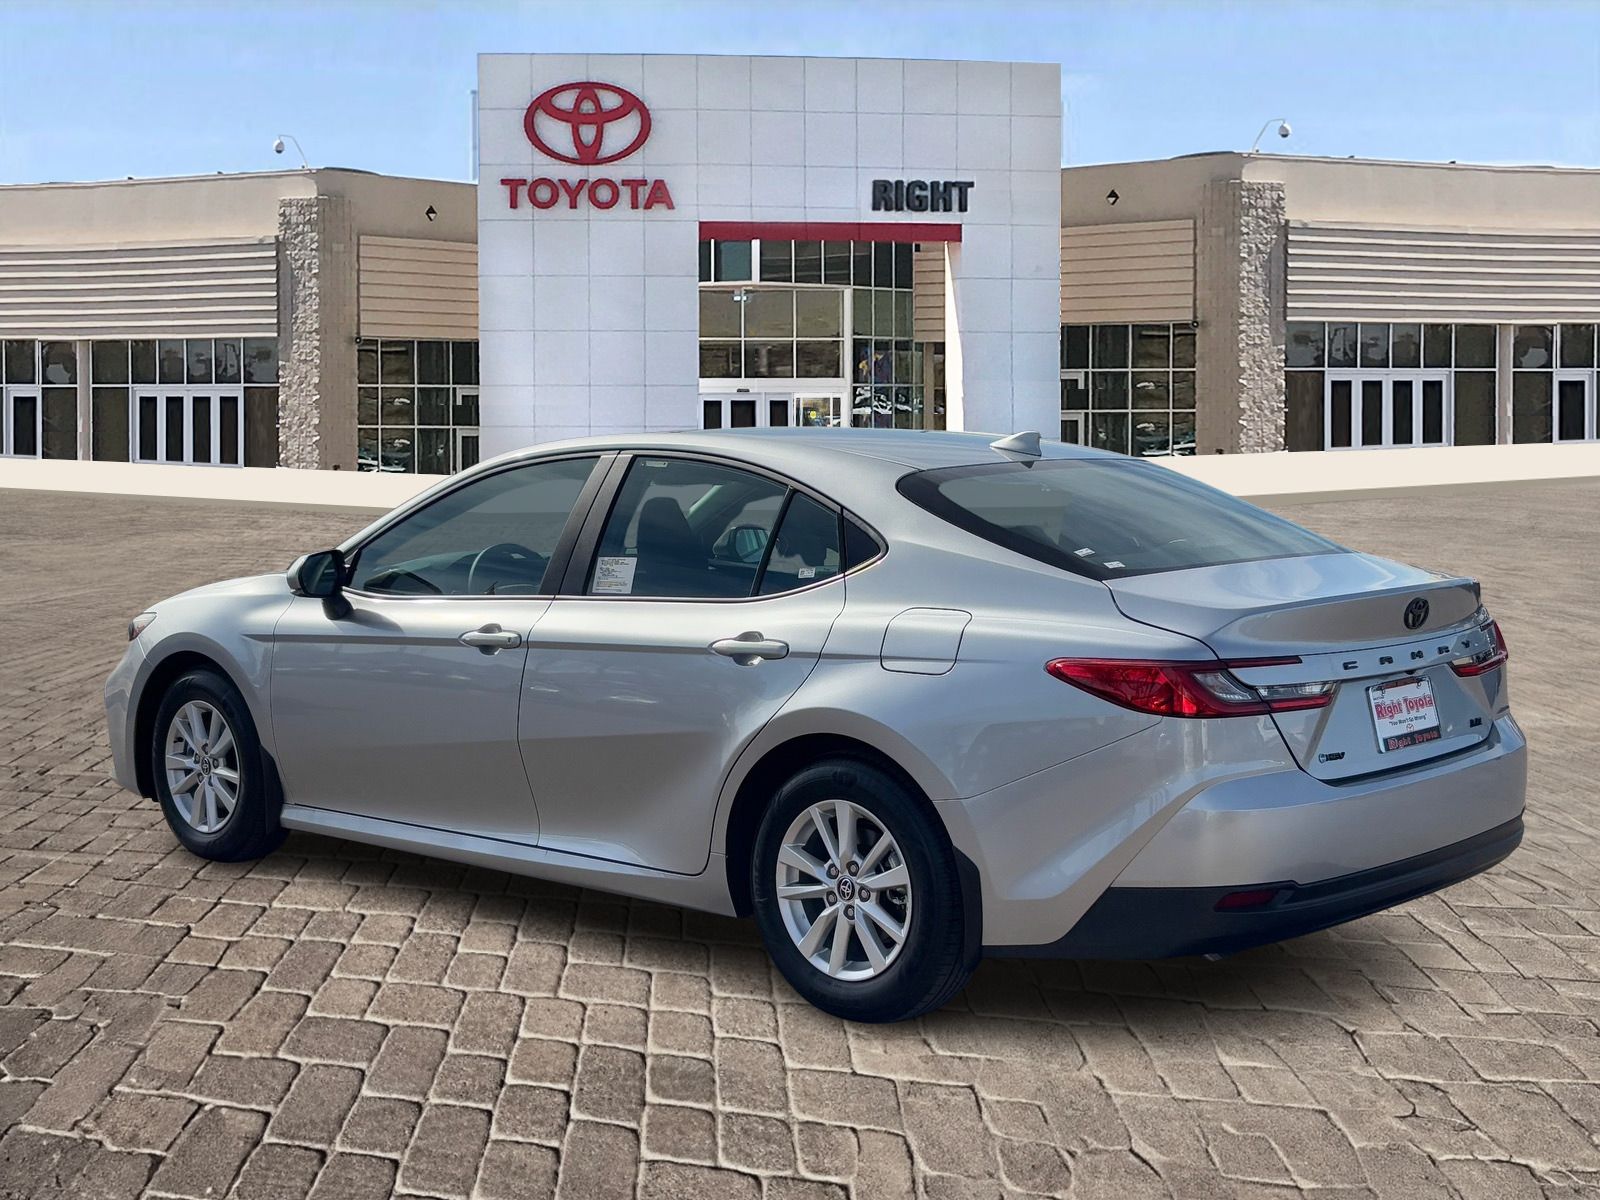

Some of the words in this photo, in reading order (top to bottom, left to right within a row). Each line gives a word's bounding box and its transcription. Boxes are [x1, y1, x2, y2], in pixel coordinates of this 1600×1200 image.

[500, 177, 675, 210] TOYOTA
[872, 179, 975, 213] RIGHT
[1343, 640, 1470, 671] CAMRY
[1374, 699, 1403, 720] Right
[1403, 694, 1433, 714] Toyota
